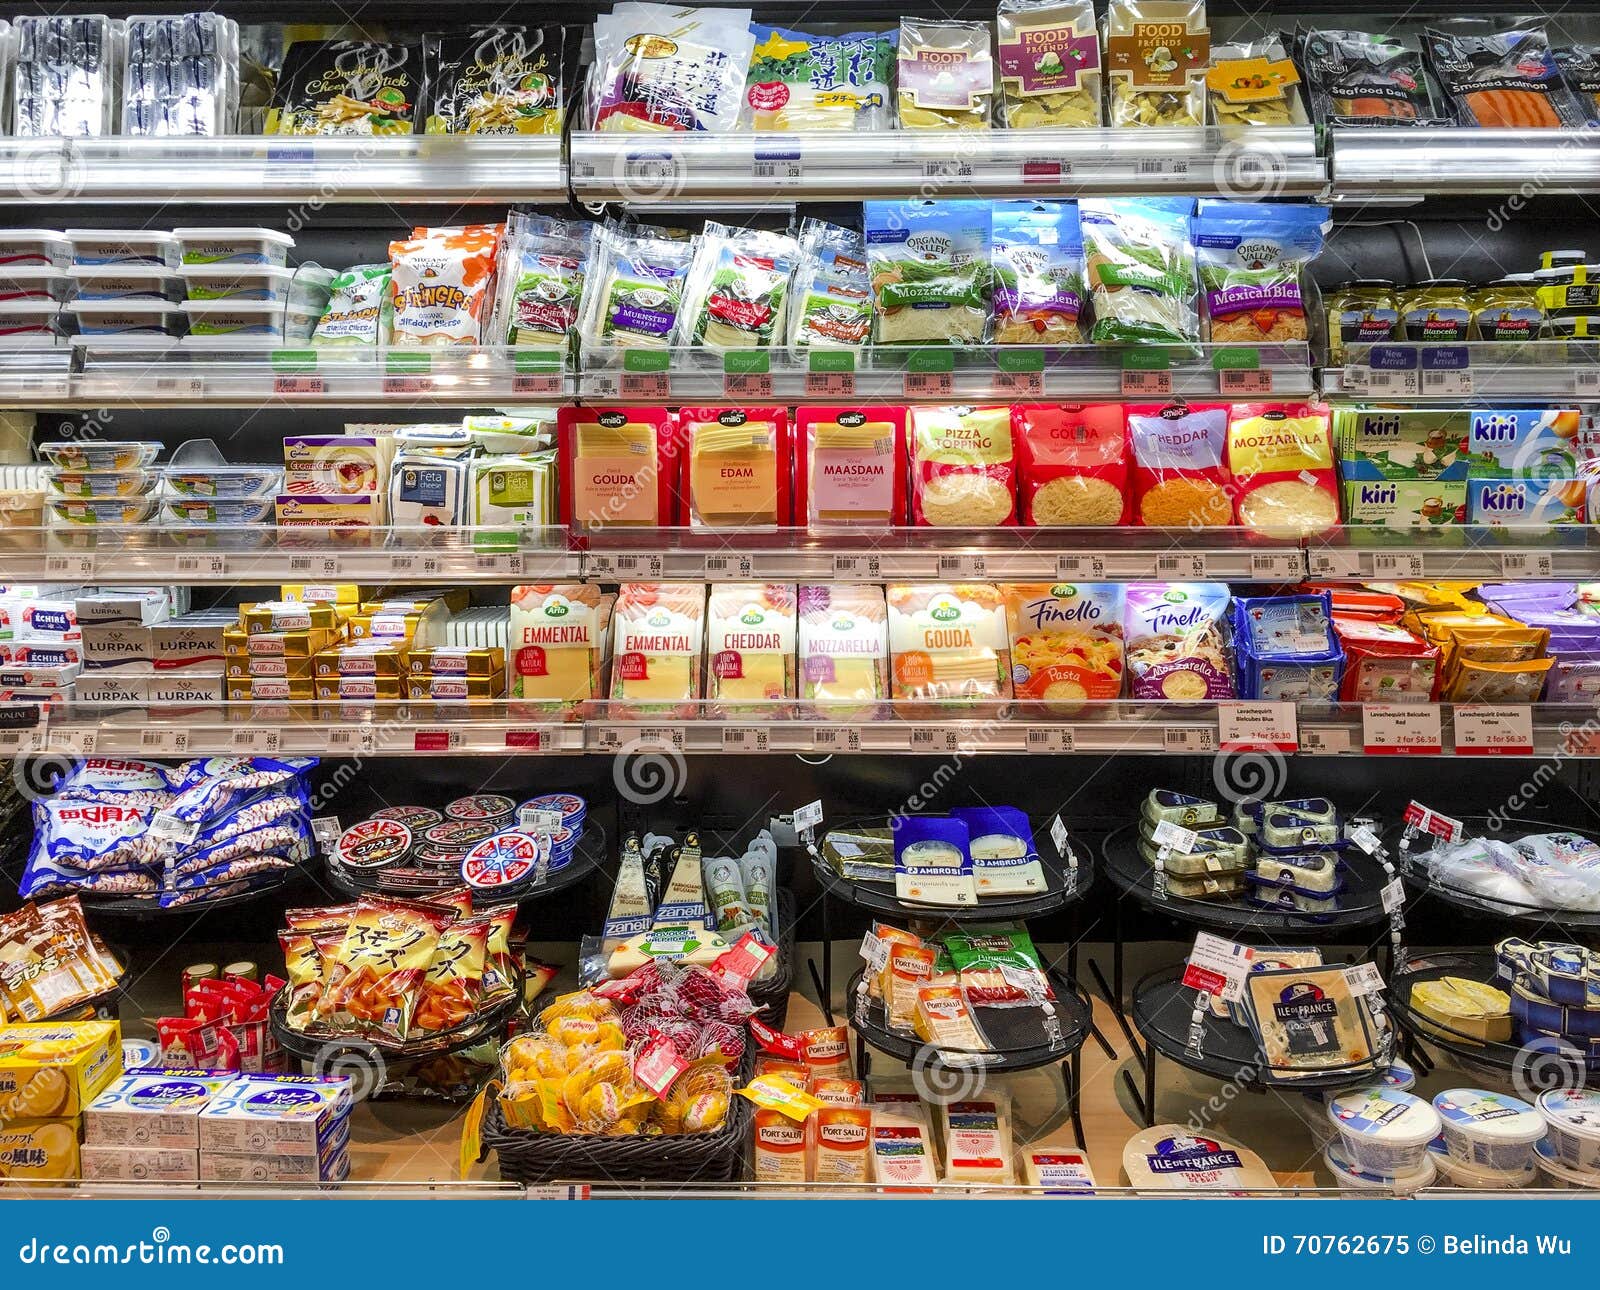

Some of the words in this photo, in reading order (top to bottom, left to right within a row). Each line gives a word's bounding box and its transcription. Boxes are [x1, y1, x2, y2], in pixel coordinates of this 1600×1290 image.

[1138, 24, 1182, 37] FOOD
[1025, 30, 1069, 45] FOOD
[1138, 39, 1182, 47] FRIENDS
[1026, 42, 1069, 54] FRIENDS
[922, 53, 963, 64] FOOD
[323, 64, 379, 80] Smoked
[1452, 79, 1502, 93] Smoked
[1505, 79, 1548, 91] Salmon
[1332, 85, 1384, 96] Seafood
[1386, 88, 1408, 99] Deli
[907, 235, 951, 247] ORGANIC
[98, 247, 131, 255] LURPAK
[203, 246, 235, 254] LURPAK
[914, 243, 947, 255] VALLEY
[1237, 244, 1282, 257] ORGANIC
[1240, 252, 1274, 263] VALLEY
[209, 282, 242, 290] LURPAK
[897, 286, 965, 298] Mozzarella
[1214, 288, 1271, 306] Mexican
[1273, 286, 1301, 299] Blen
[623, 309, 668, 325] MUENSTER
[1131, 354, 1160, 363] Organic
[1221, 354, 1250, 363] Organic
[1385, 350, 1402, 358] New
[1437, 350, 1454, 358] New
[632, 355, 663, 366] Organic
[732, 357, 761, 367] Organic
[817, 357, 847, 366] Organic
[916, 357, 945, 367] Organic
[1007, 357, 1037, 366] Organic
[1381, 356, 1407, 366] Arrival
[1433, 356, 1459, 366] Arrival
[1364, 414, 1400, 436] kiri
[1475, 415, 1516, 441] kiri
[945, 428, 981, 440] PIZZA
[935, 438, 992, 449] TOPPING
[290, 461, 315, 471] Cream
[316, 461, 346, 471] Cheese
[823, 465, 885, 476] MAASDAM
[420, 470, 443, 482] Feta
[720, 468, 754, 478] EDAM
[507, 477, 528, 487] Feta
[592, 474, 636, 485] GOUDA
[419, 481, 443, 490] cheese
[1361, 483, 1396, 504] kiri
[1483, 484, 1526, 511] kiri
[1053, 586, 1075, 596] Arla
[91, 607, 122, 615] LURPAK
[548, 605, 565, 615] Arla
[934, 608, 958, 619] Arla
[1027, 598, 1100, 630] Finello
[34, 611, 65, 624] ÉCHIRÉ
[651, 616, 669, 626] Arla
[743, 614, 761, 624] Arla
[834, 620, 852, 630] Arla
[523, 625, 590, 644] EMMENTAL
[924, 629, 973, 649] GOUDA
[160, 640, 216, 651] LURPAK
[625, 635, 693, 651] EMMENTAL
[724, 633, 781, 649] CHEDDAR
[808, 639, 880, 654] MOZZARELLA
[89, 642, 144, 652] LURPAK
[32, 650, 65, 663] ÉCHIRÉ
[524, 650, 539, 660] 100%
[625, 655, 641, 665] 100%
[720, 654, 735, 664] 100%
[904, 655, 923, 666] 100%
[622, 664, 643, 673] NATURAL
[717, 662, 739, 671] NATURAL
[1048, 668, 1081, 682] Pasta
[84, 691, 140, 701] LURPAK
[157, 691, 213, 701] LURPAK
[1257, 732, 1269, 740] for
[1270, 731, 1291, 740] $6.30
[1403, 735, 1415, 743] for
[1416, 735, 1437, 744] $6.30
[1493, 735, 1505, 743] for
[1506, 735, 1527, 744] $6.30
[986, 857, 1027, 867] AMBROSI
[919, 867, 961, 876] AMBROSI
[657, 904, 705, 918] zanetti
[894, 959, 911, 968] PORT
[911, 961, 931, 971] SALUT
[926, 1001, 943, 1009] PORT
[944, 1000, 962, 1009] SALUT
[1277, 1007, 1290, 1016] ILE
[1298, 1003, 1332, 1016] FRANCE
[808, 1045, 825, 1055] PORT
[826, 1042, 845, 1052] SALUT
[162, 1069, 208, 1077] ネオソフト
[276, 1074, 328, 1083] ネオソフト
[816, 1093, 834, 1102] PORT
[834, 1095, 855, 1104] SALUT
[761, 1128, 780, 1138] PORT
[781, 1130, 803, 1140] SALUT
[823, 1126, 841, 1136] PORT
[842, 1127, 867, 1137] SALUT
[1153, 1158, 1173, 1170] ILE
[1185, 1155, 1237, 1168] FRANCE
[1180, 1170, 1223, 1179] TRANCHES
